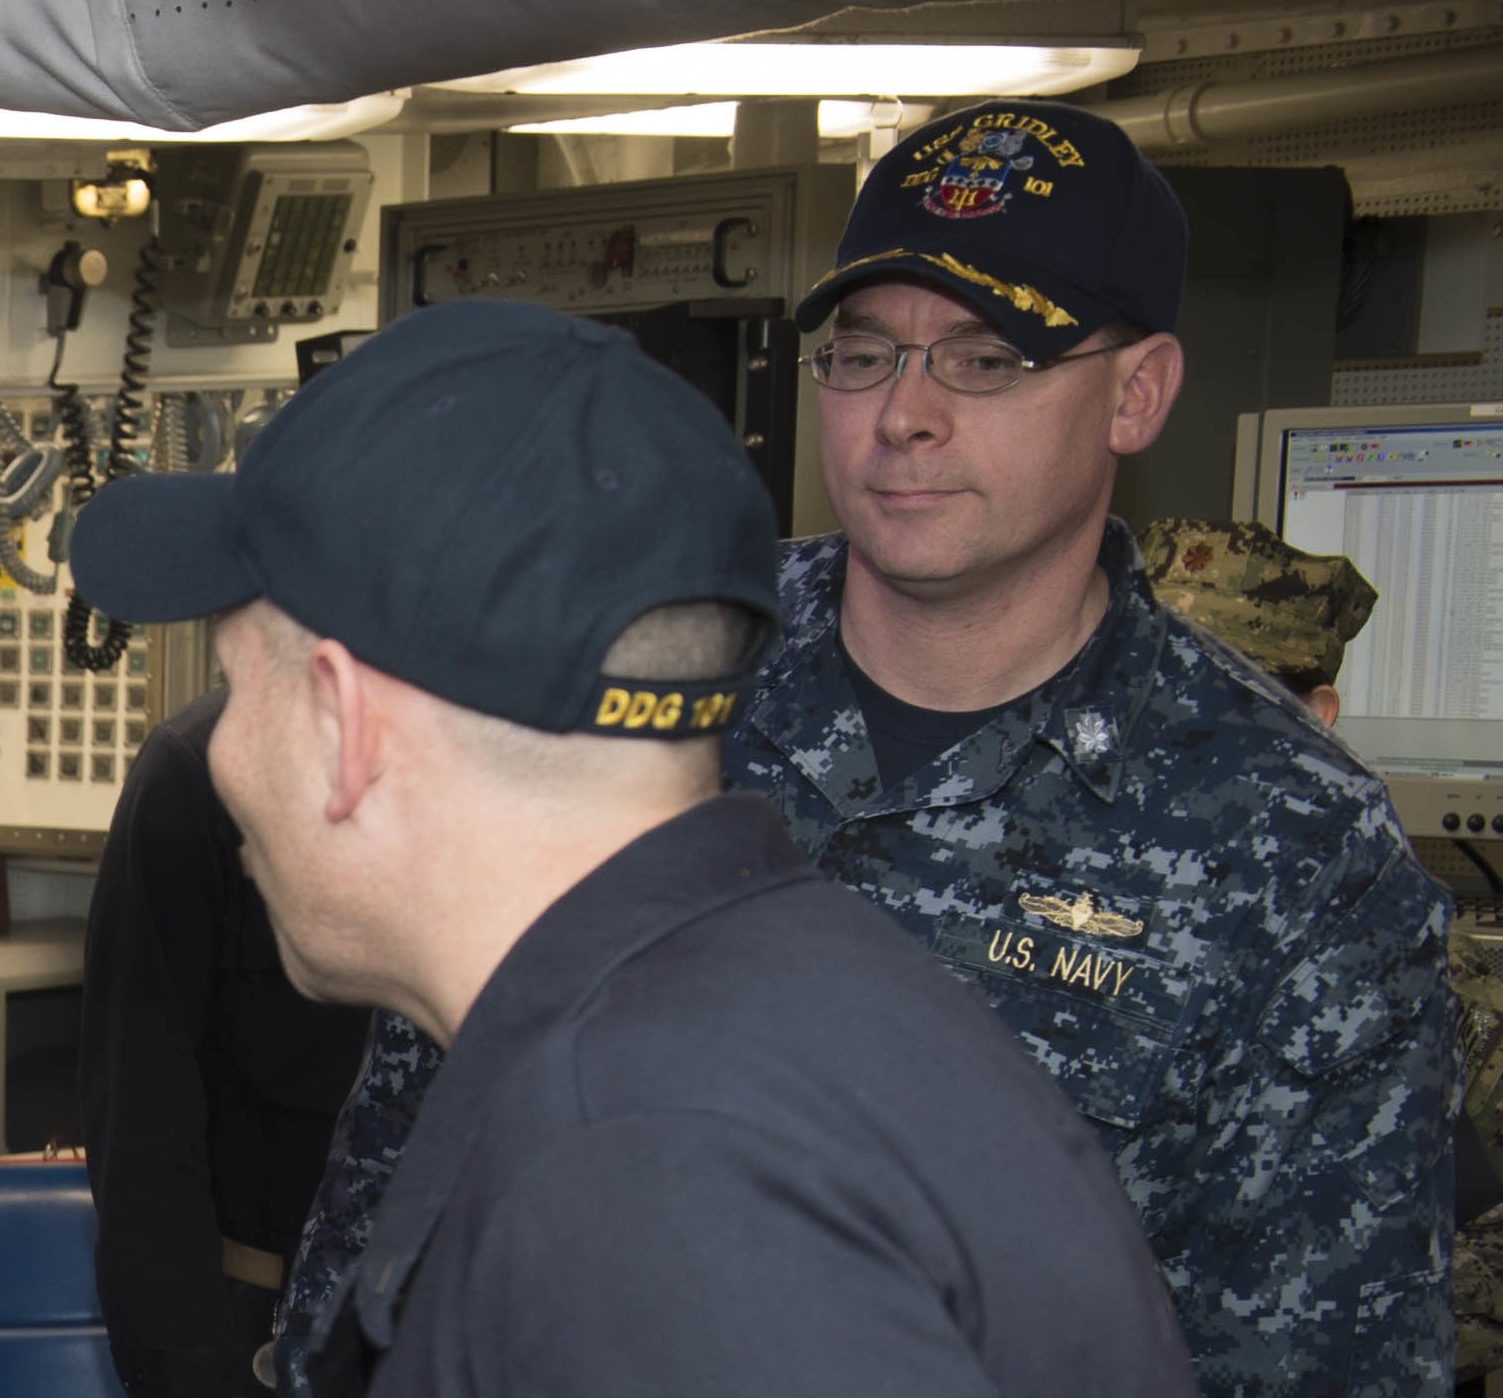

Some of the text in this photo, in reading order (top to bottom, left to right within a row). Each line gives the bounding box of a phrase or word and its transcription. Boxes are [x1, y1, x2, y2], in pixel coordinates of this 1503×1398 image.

[973, 112, 1085, 169] GRIDLEY
[1024, 175, 1055, 198] 101
[595, 687, 685, 730] DDG
[988, 929, 1135, 996] U.S. NAVY
